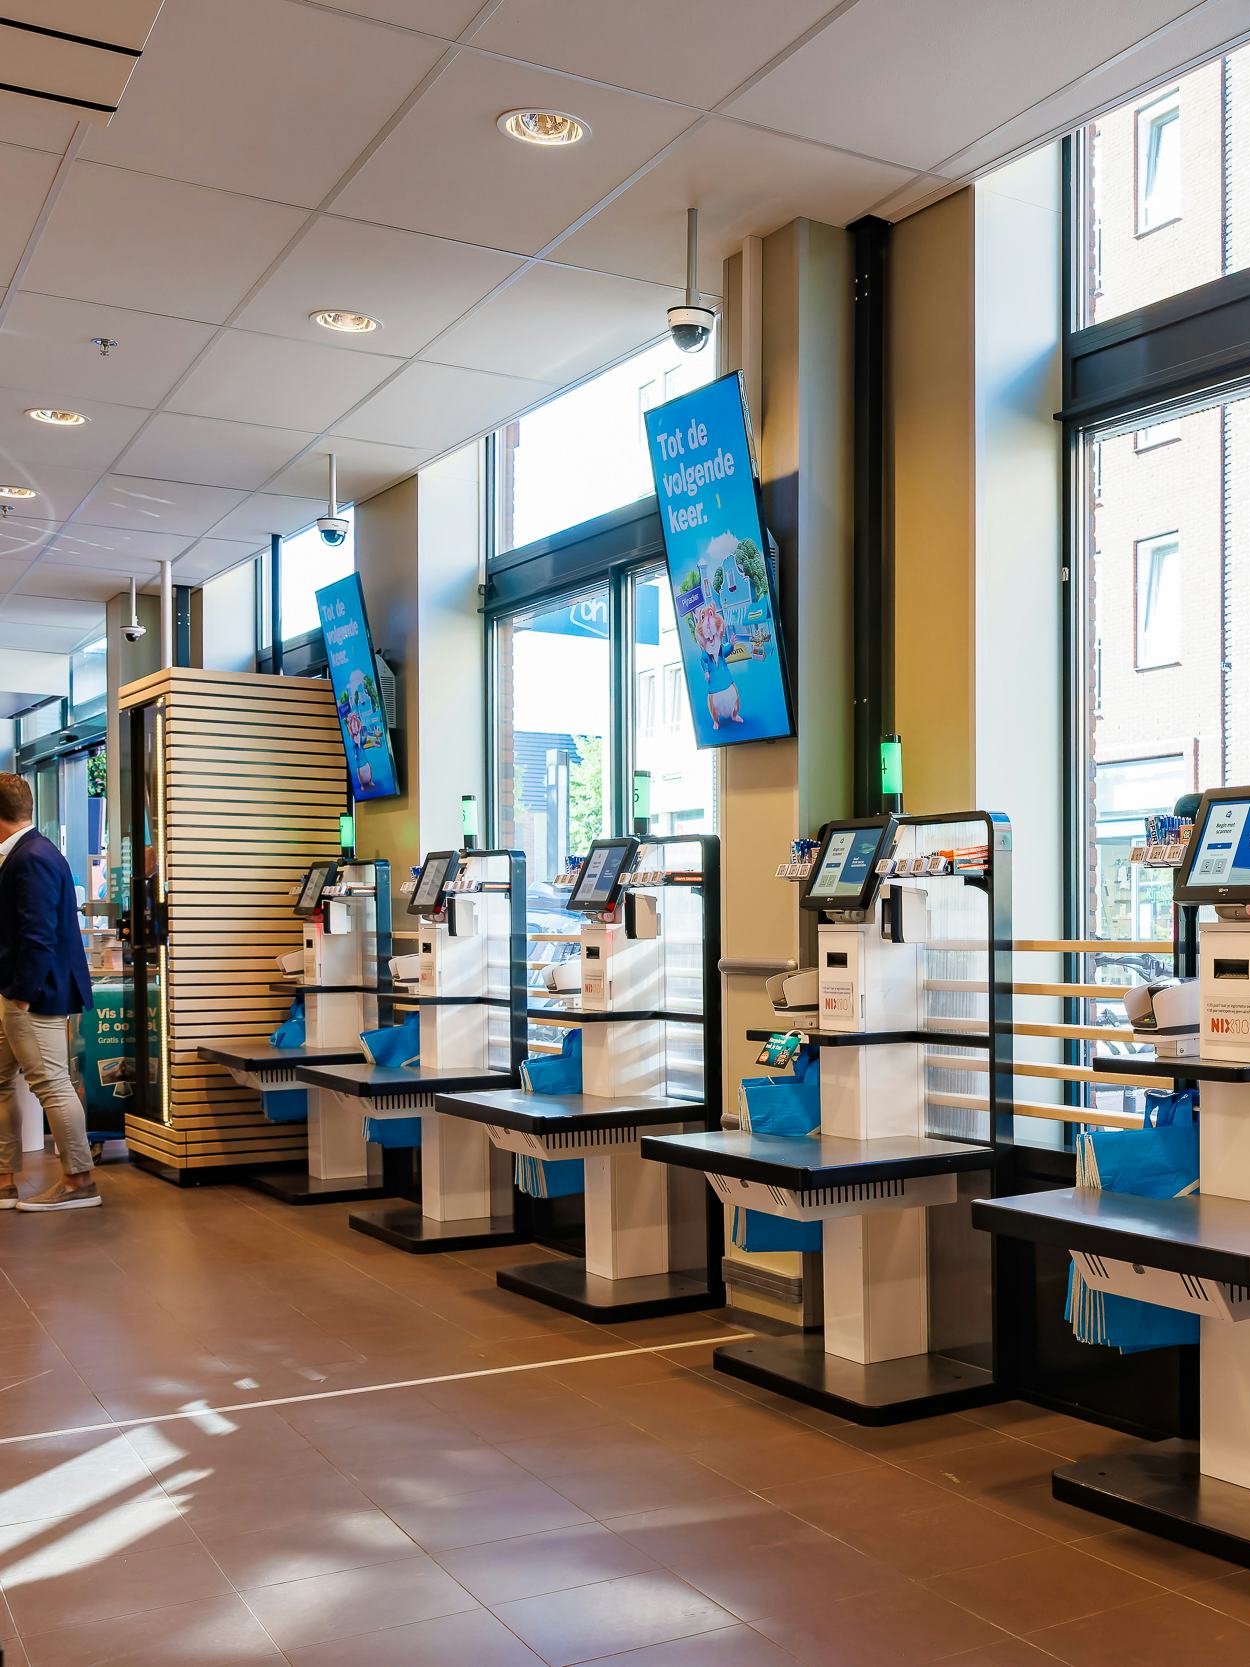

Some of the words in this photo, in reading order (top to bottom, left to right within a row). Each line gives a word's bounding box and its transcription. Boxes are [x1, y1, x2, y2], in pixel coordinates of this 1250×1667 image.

[657, 428, 685, 461] Tot
[688, 418, 708, 450] de
[663, 448, 735, 498] volgende
[668, 502, 708, 534] keer.
[321, 605, 336, 622] Tot
[335, 598, 346, 616] de
[326, 619, 359, 645] volgende
[96, 1008, 117, 1019] Vis
[97, 1021, 110, 1034] je
